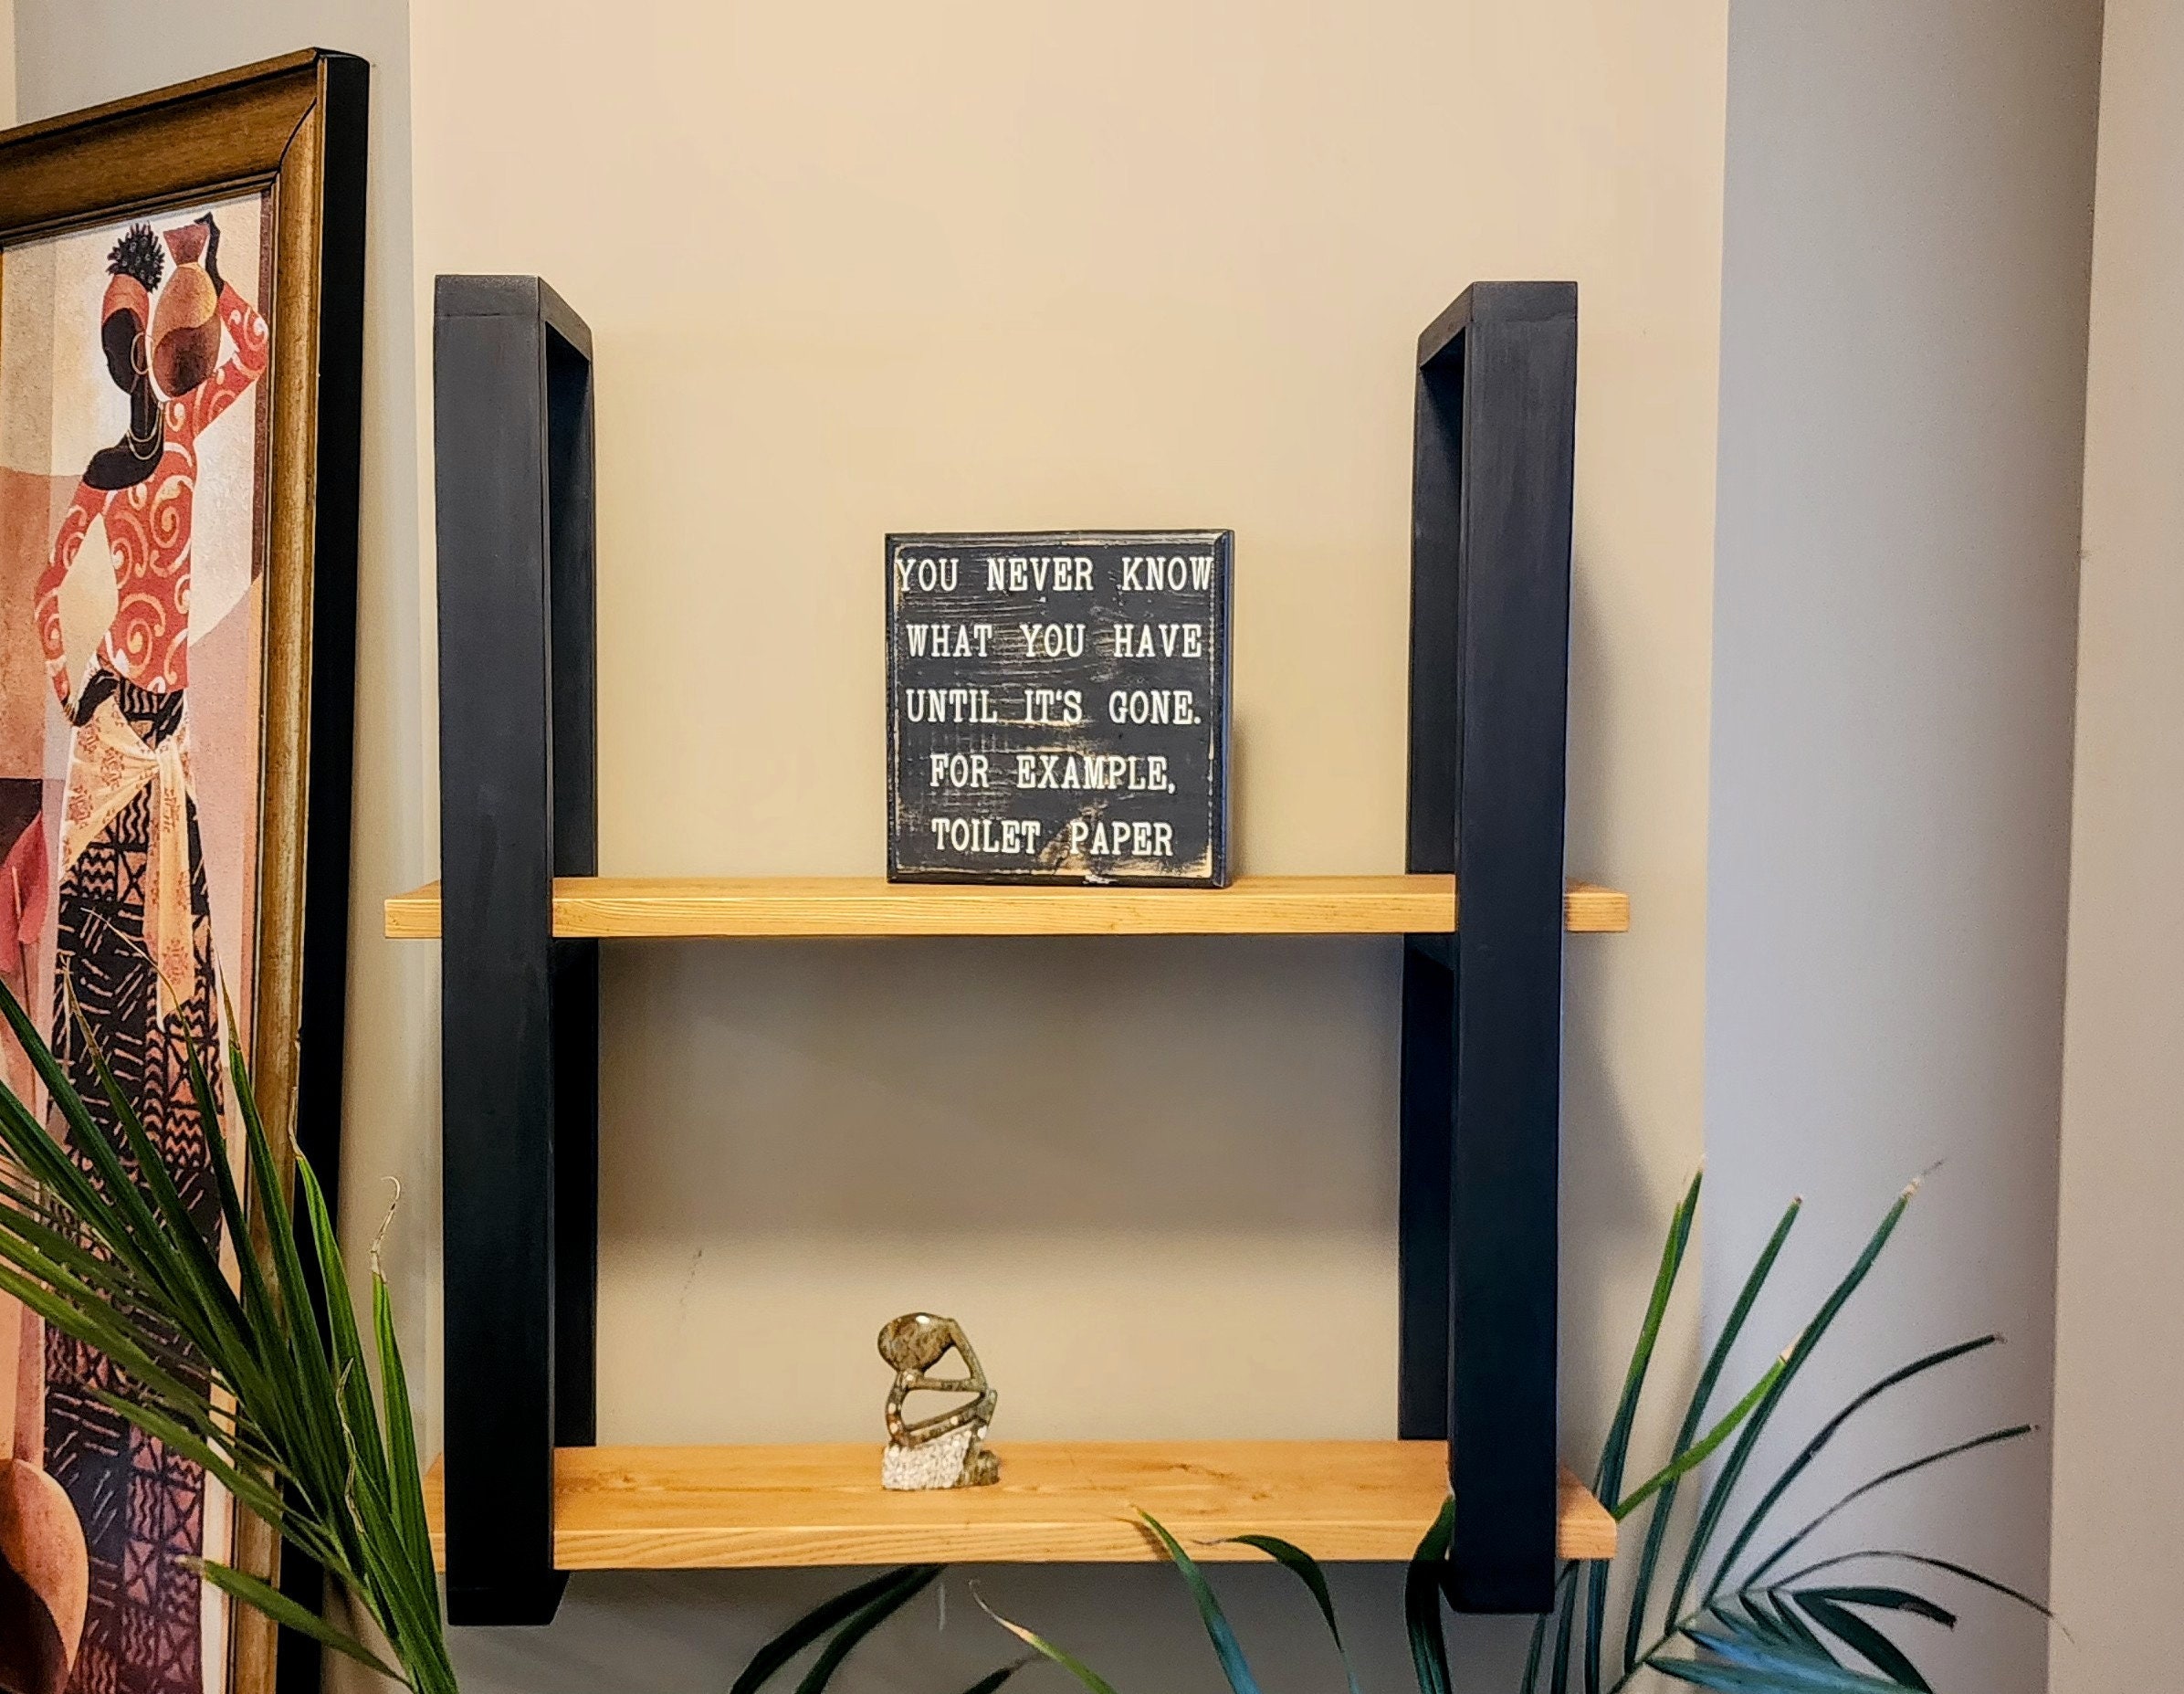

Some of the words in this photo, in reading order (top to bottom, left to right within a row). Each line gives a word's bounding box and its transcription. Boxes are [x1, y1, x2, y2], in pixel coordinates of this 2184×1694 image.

[896, 559, 958, 591] YOU
[987, 557, 1094, 591] NEVER
[1122, 557, 1213, 591] KNOW
[907, 625, 992, 658] WHAT
[1020, 625, 1086, 658] YOU
[1115, 625, 1202, 658] HAVE
[907, 689, 997, 723] UNTIL
[1024, 689, 1082, 723] IT'S
[1109, 690, 1202, 725] GONE.
[930, 754, 989, 787] FOR
[1016, 756, 1176, 794] EXAMPLE,
[932, 819, 1040, 854] TOILET
[1070, 822, 1173, 856] PAPER
